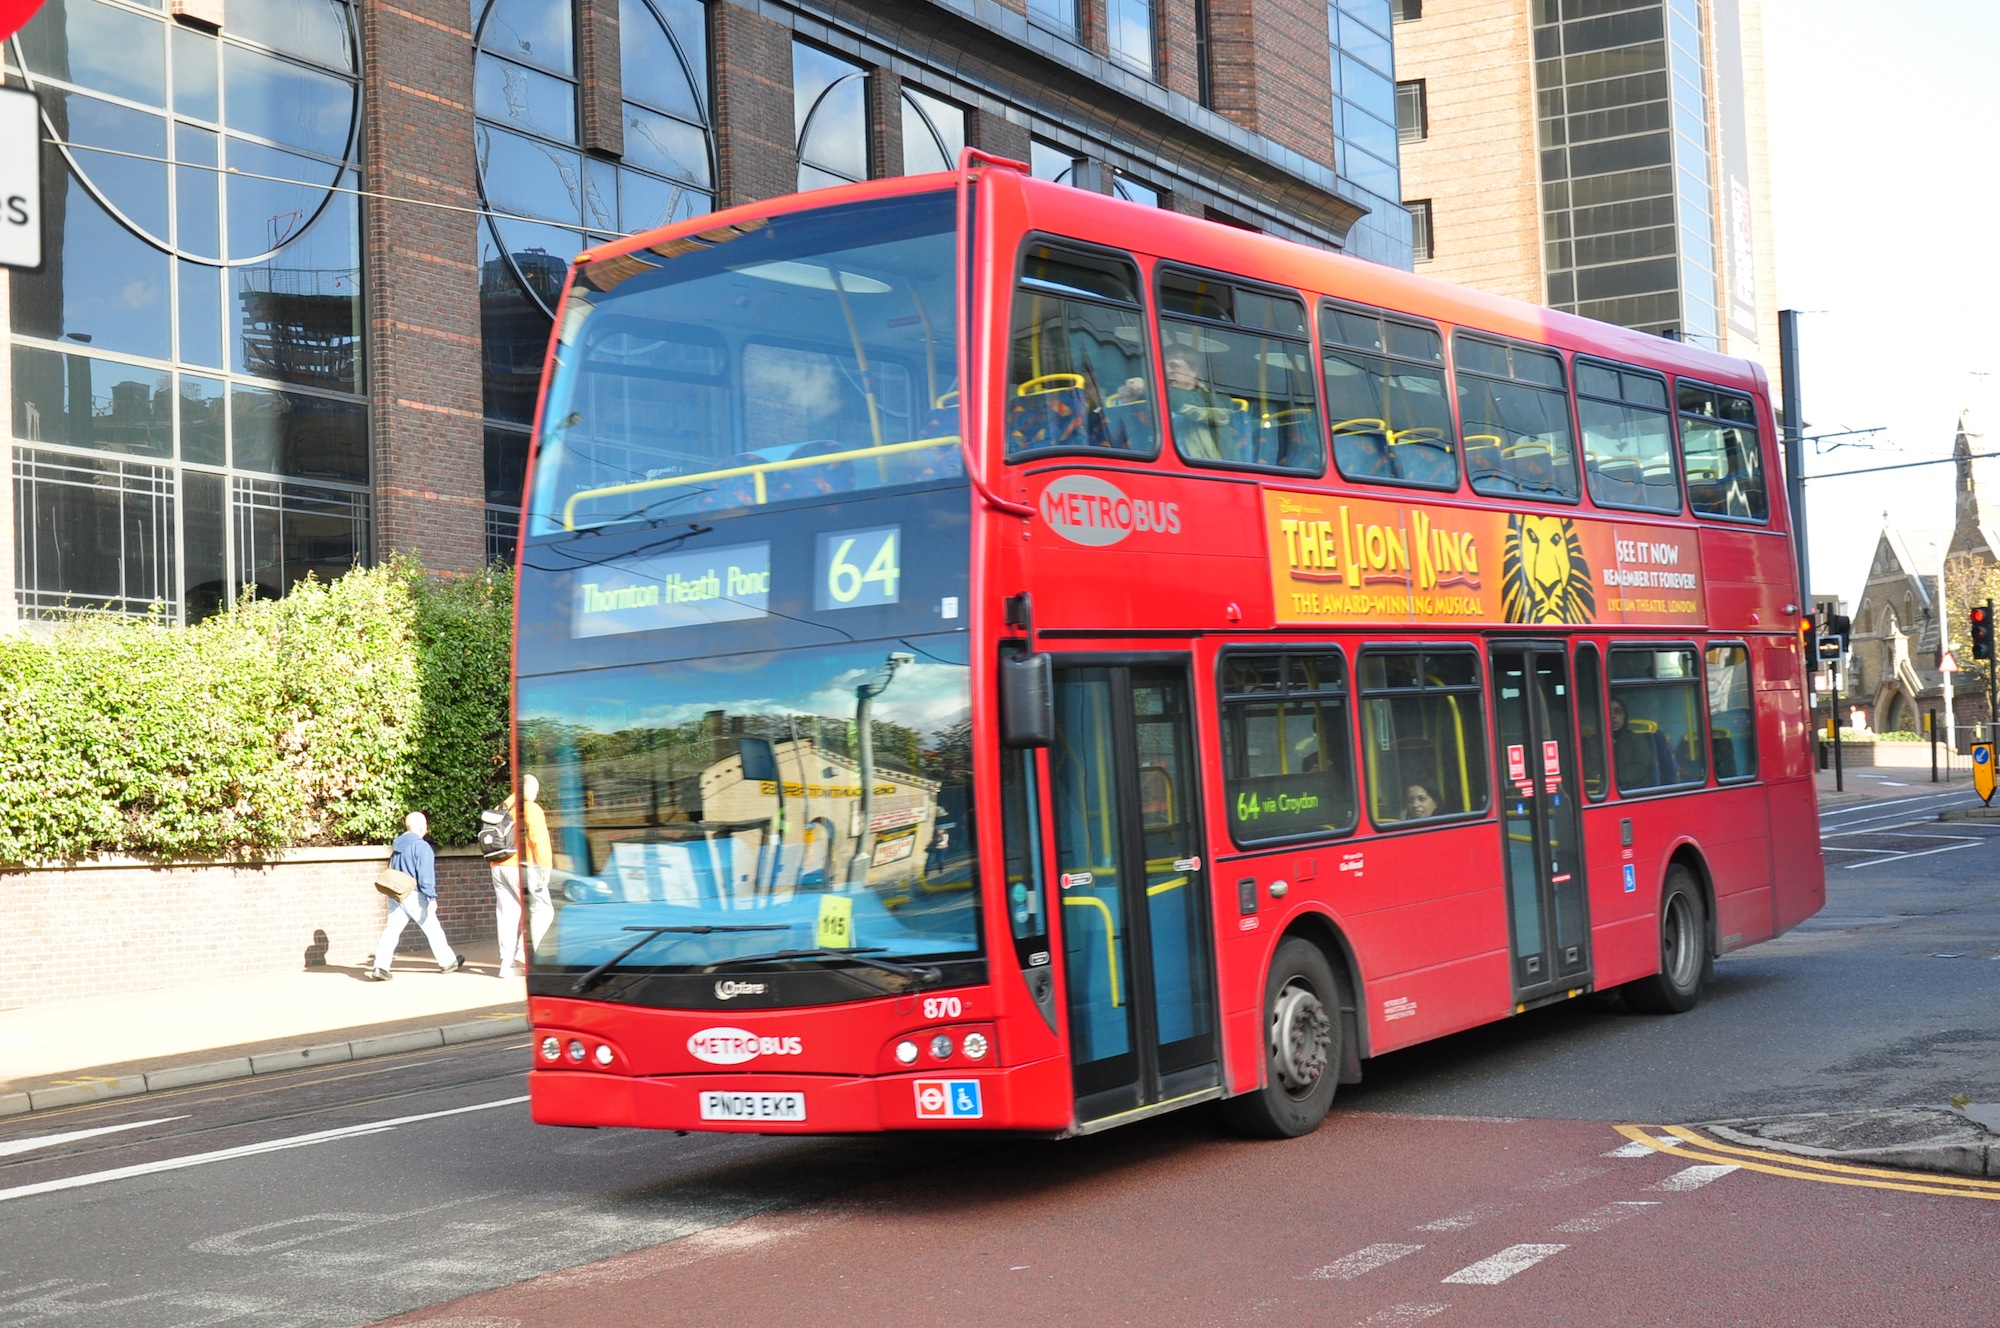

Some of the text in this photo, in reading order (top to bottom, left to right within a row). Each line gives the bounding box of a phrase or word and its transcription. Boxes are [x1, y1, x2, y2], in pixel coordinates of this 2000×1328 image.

[0, 195, 29, 226] s
[1045, 490, 1182, 535] METROBUS
[1281, 519, 1337, 568] THE
[1616, 540, 1679, 565] SEE IT NOW
[828, 533, 900, 603] 64
[1603, 569, 1650, 587] REMEMBER
[1650, 571, 1659, 587] IT
[582, 583, 659, 613] Thornton
[665, 569, 720, 604] Heath
[1291, 593, 1484, 616] THE AWARD-WINNING MUSICAL
[1668, 600, 1697, 613] LONDON
[1237, 792, 1319, 821] 64 via Croydon
[721, 981, 766, 998] Optare
[923, 997, 962, 1019] 870
[692, 1036, 803, 1055] METROBUS
[709, 1096, 797, 1117] PN09 EKR
